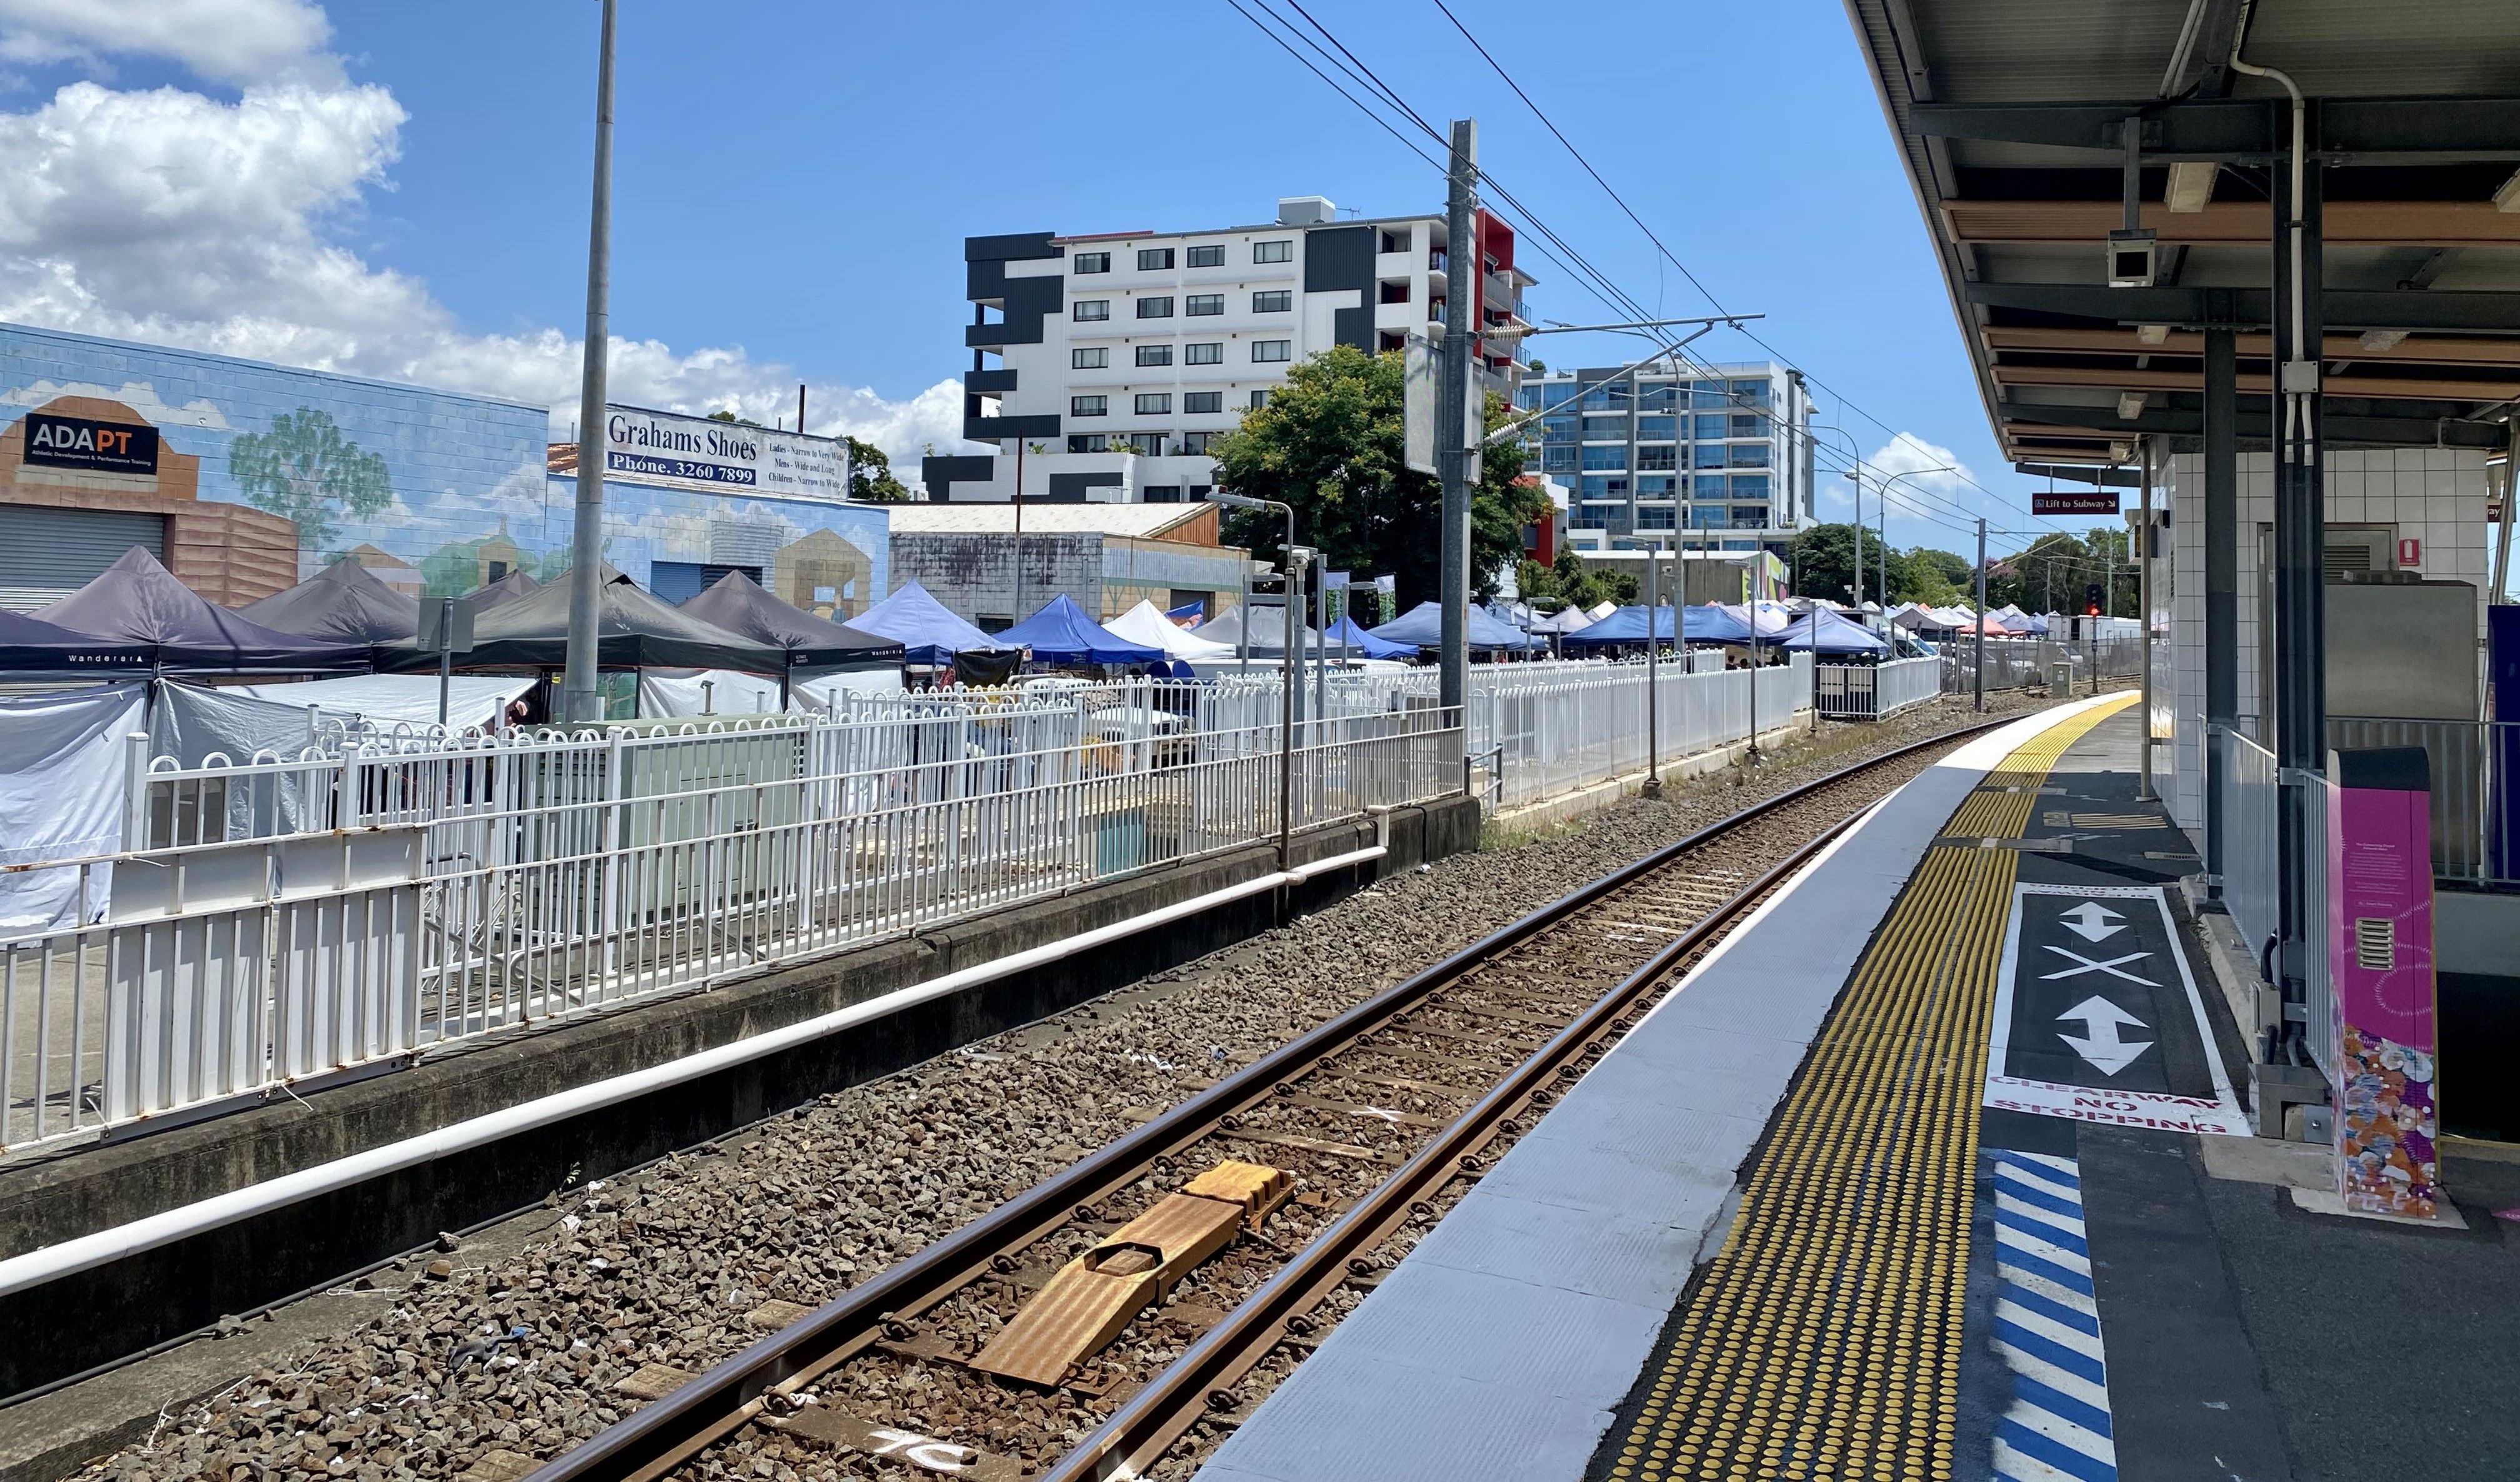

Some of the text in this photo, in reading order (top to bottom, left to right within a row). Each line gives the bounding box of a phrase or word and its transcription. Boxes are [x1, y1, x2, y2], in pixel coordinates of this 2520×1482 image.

[32, 424, 132, 454] ADAPT
[609, 415, 756, 460] Grahams Shoes
[54, 452, 90, 460] Development
[97, 455, 130, 464] Performance
[769, 443, 786, 453] Ladies
[791, 445, 811, 456] Narrow
[812, 449, 818, 457] to
[818, 449, 831, 461] Very
[831, 450, 844, 462] Wide
[612, 454, 752, 482] Phone. 3260 7899
[775, 457, 789, 467] Mens
[794, 461, 809, 470] Wide
[809, 464, 820, 472] and
[821, 465, 835, 475] Long
[769, 472, 792, 483] Children
[798, 476, 818, 486] Narrow
[826, 479, 839, 488] Wide
[2046, 499, 2060, 508] Lift
[2073, 499, 2106, 510] Subway
[1989, 1076, 2221, 1109] CLEARWAY
[2074, 1097, 2138, 1112] NO
[1994, 1098, 2227, 1133] STOPPING
